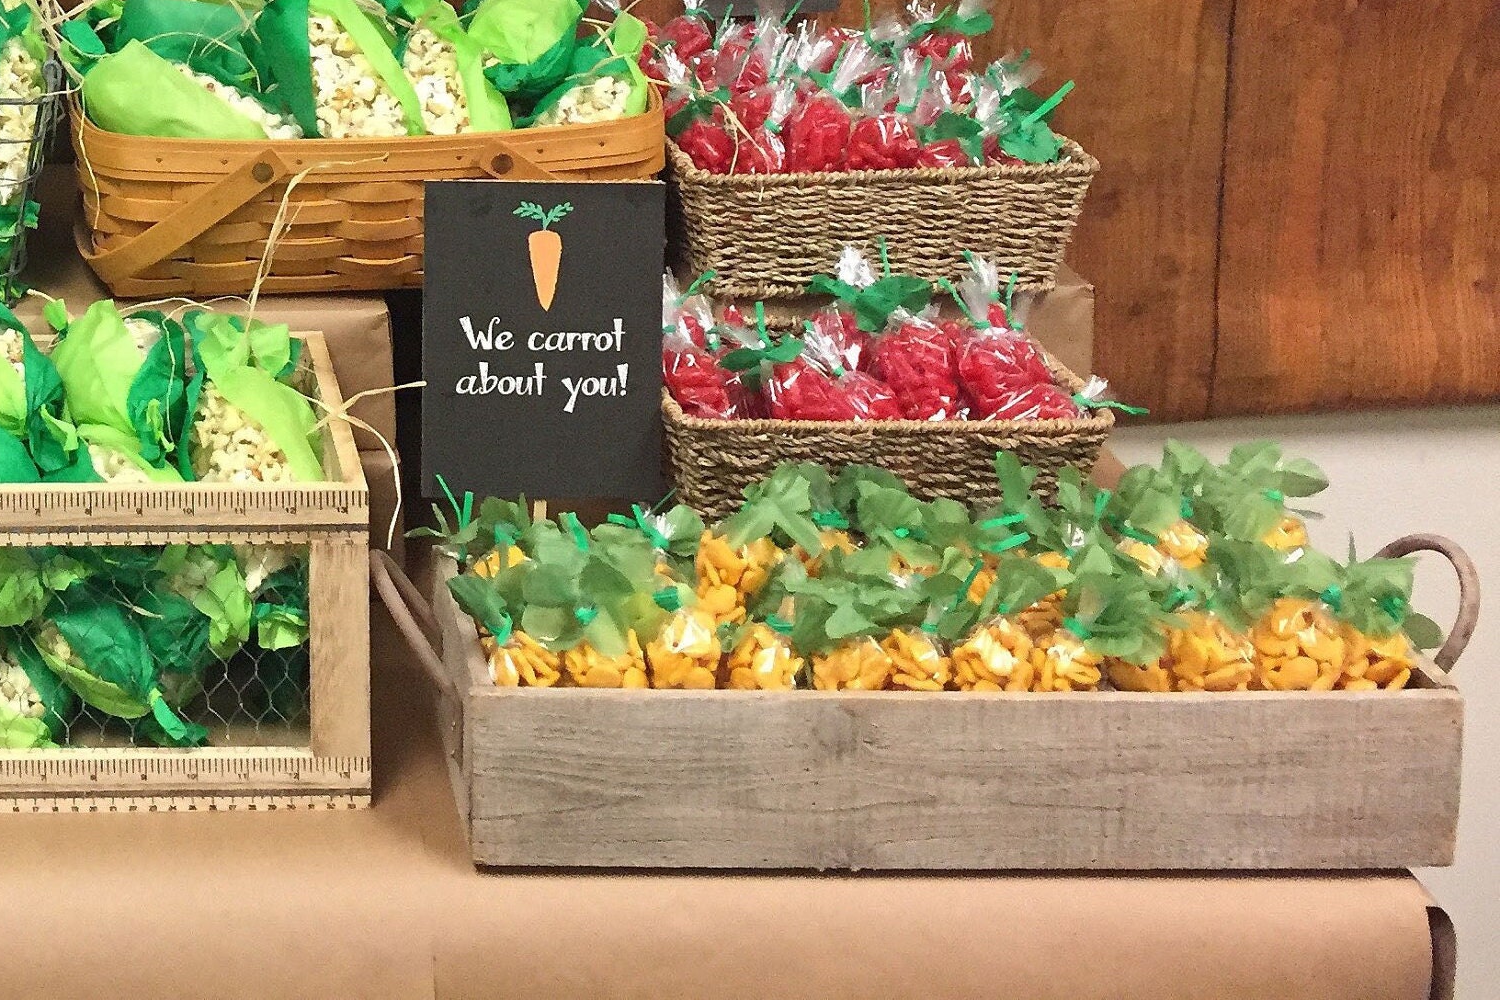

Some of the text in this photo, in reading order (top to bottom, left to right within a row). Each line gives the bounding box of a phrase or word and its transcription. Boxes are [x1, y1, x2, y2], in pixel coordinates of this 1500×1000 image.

[458, 315, 625, 351] We carrot
[455, 361, 628, 413] about you!
